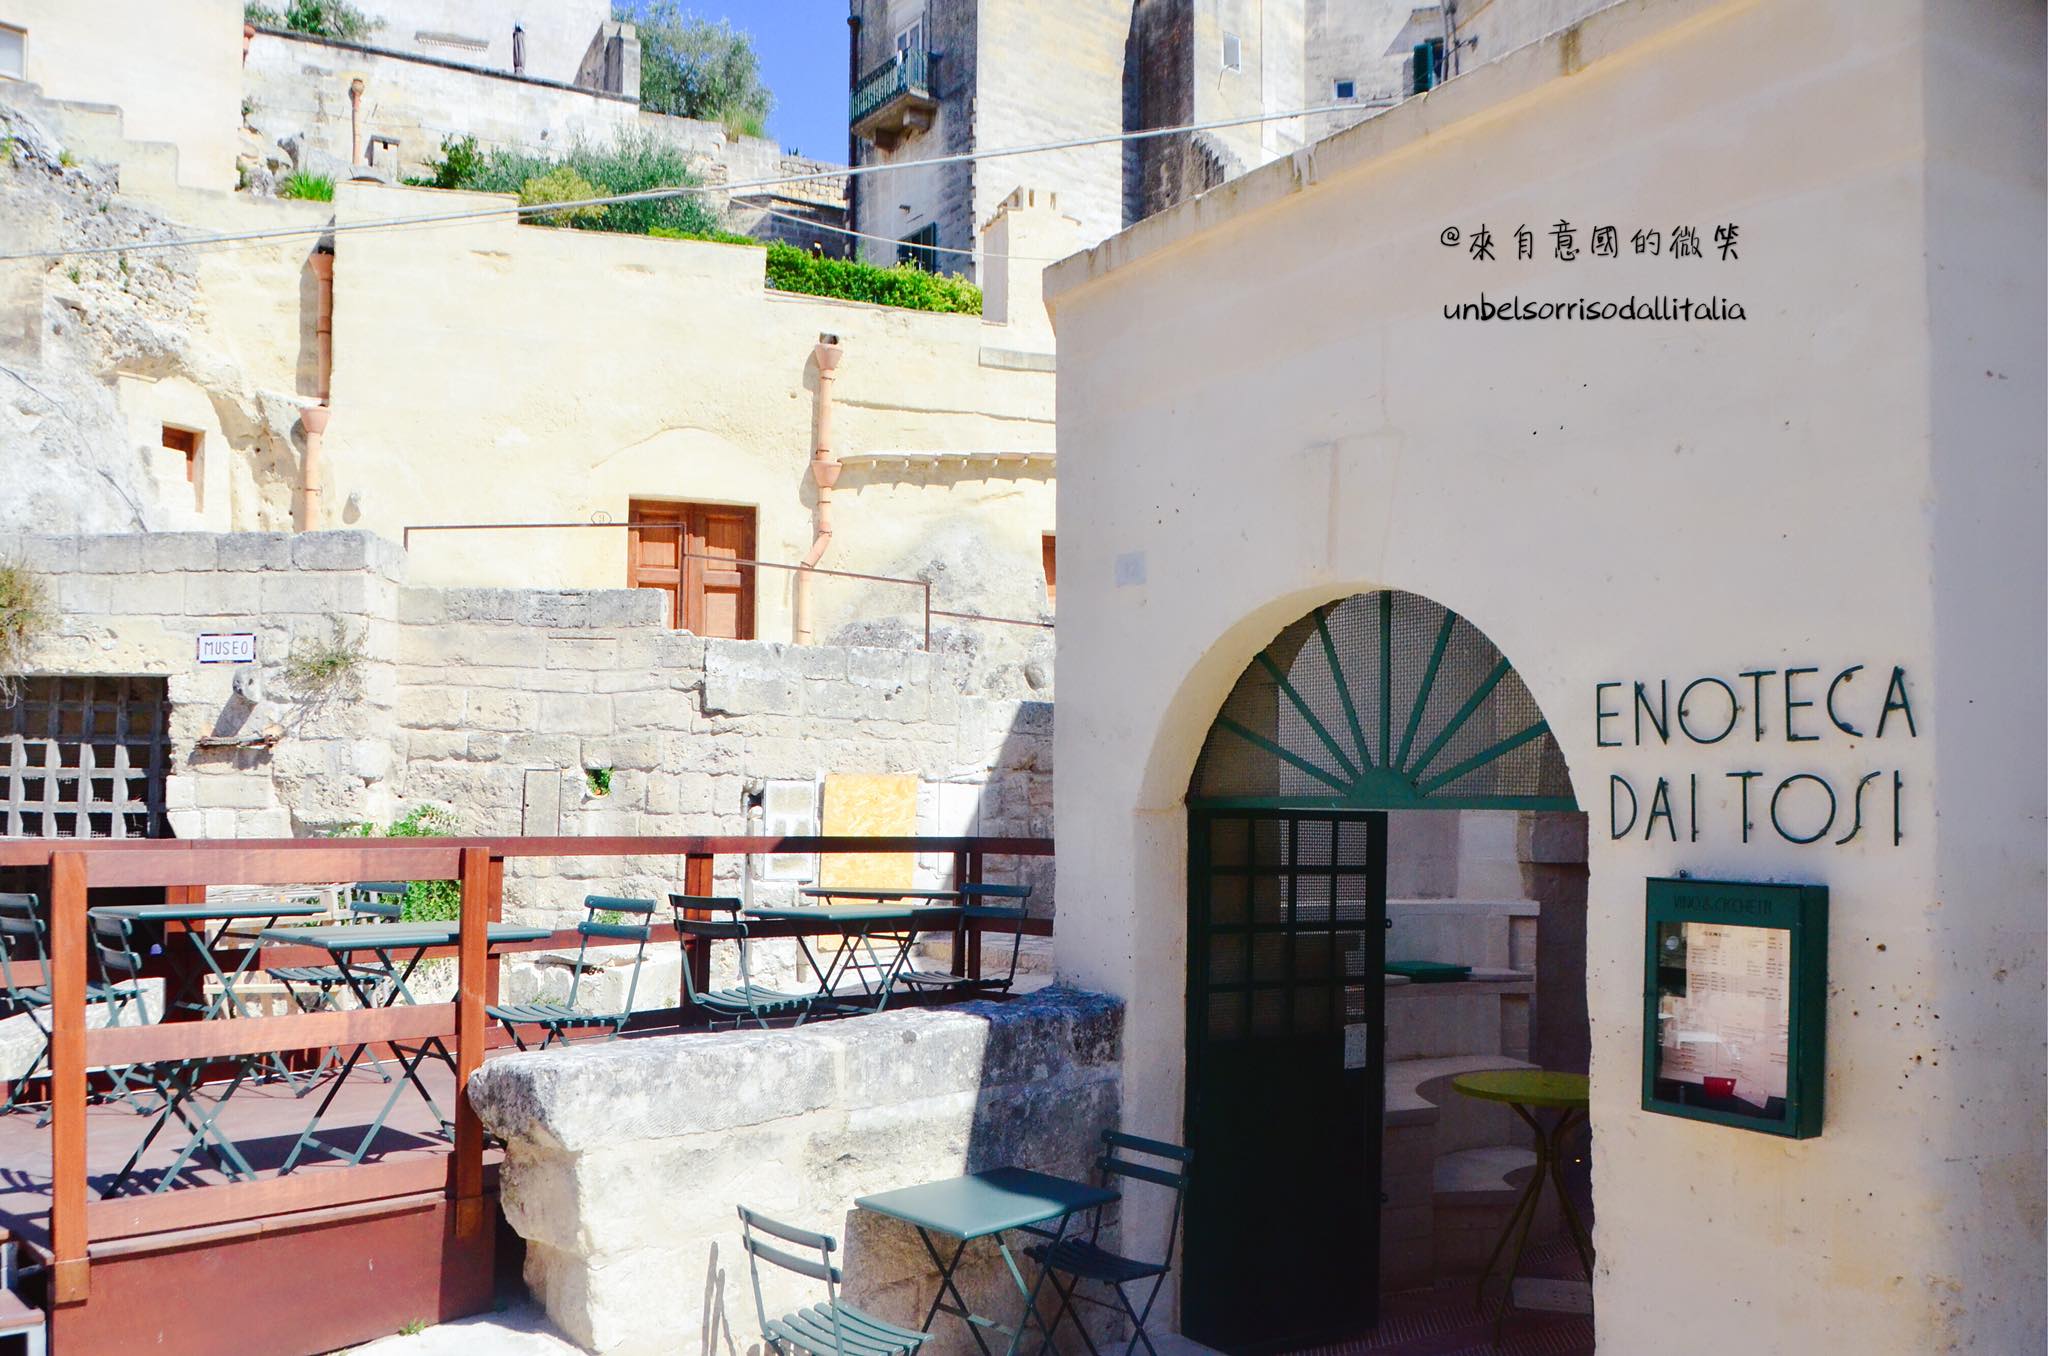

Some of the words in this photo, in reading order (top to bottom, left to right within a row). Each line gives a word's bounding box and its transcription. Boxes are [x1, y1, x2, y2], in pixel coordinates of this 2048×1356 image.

[204, 641, 249, 656] MUSEO
[1596, 664, 1917, 748] ENOTECA
[1610, 773, 1699, 843] DAI
[1725, 769, 1904, 847] TOSI
